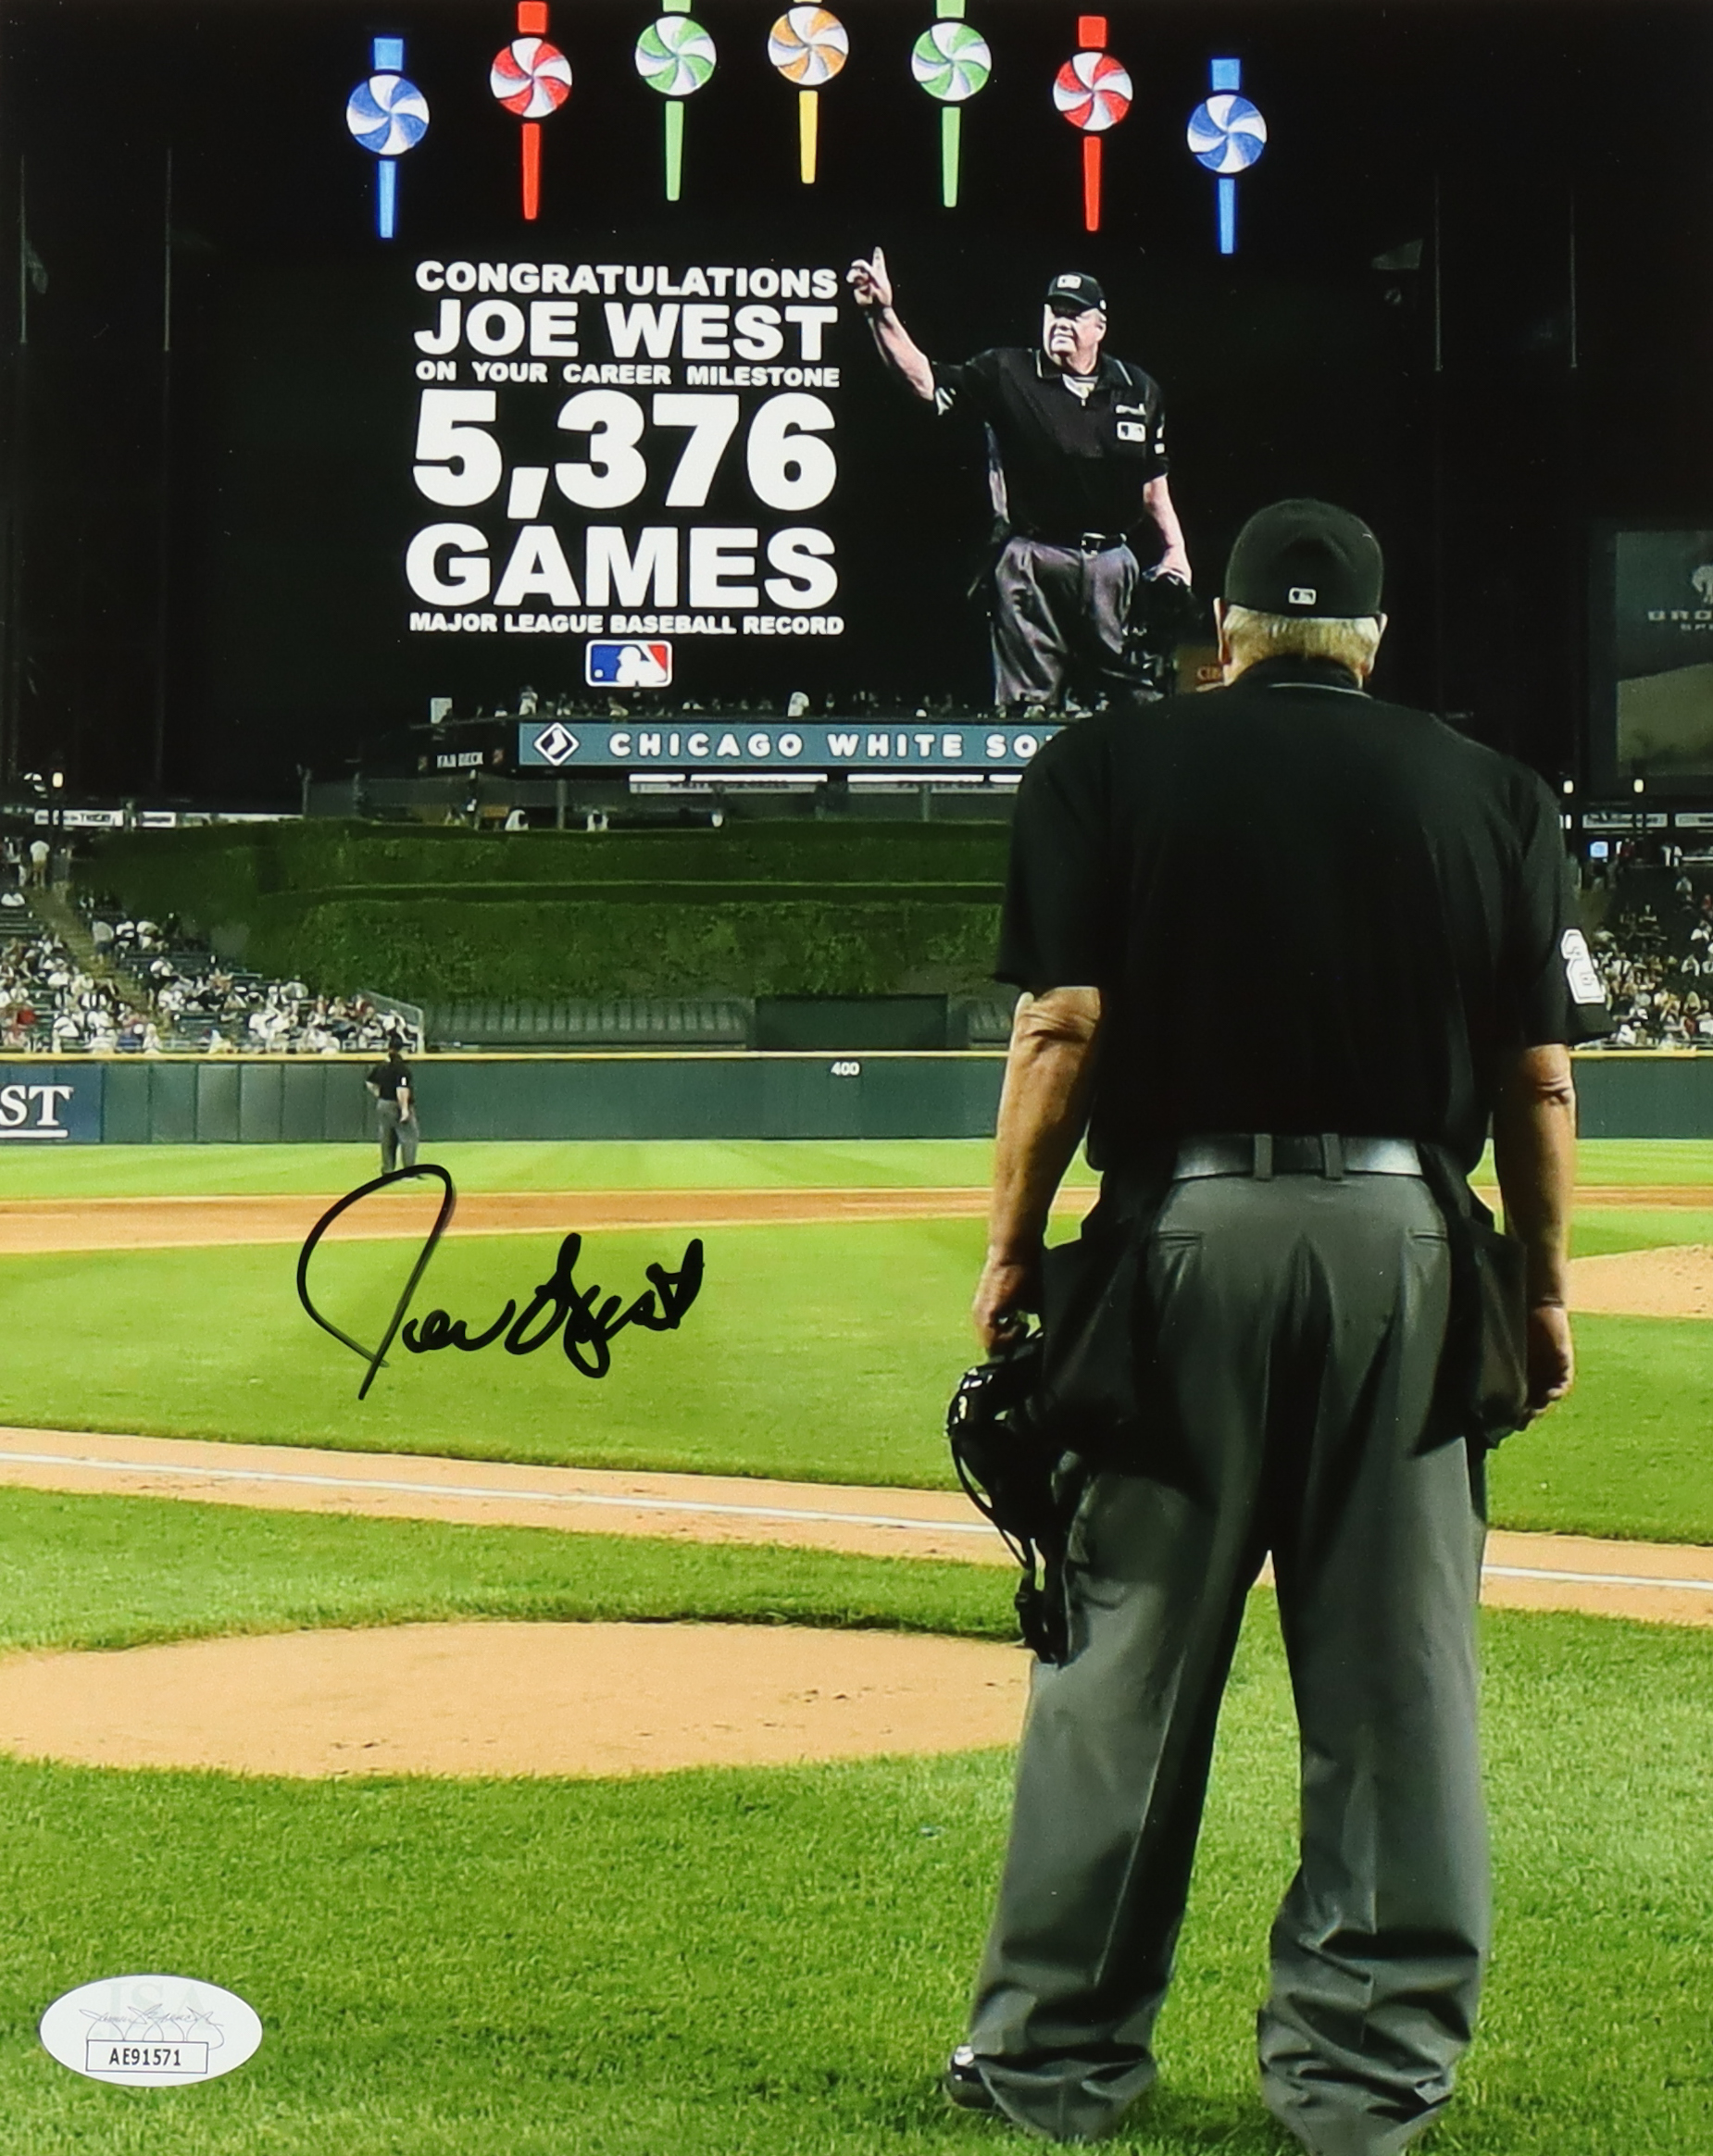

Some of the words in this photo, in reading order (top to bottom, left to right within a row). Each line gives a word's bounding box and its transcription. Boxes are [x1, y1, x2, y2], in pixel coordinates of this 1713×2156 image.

[415, 260, 838, 299] CONGRATULATIONS
[414, 299, 579, 357] JOE
[604, 302, 838, 361] WEST
[416, 360, 456, 381] ON
[471, 361, 548, 383] YOUR
[563, 363, 672, 386] CAREER
[686, 365, 840, 388] MILESTONE
[413, 388, 837, 519] 5,376
[406, 522, 838, 610] GAMES
[409, 612, 498, 633] MAJOR
[504, 613, 604, 634] LEAGUE
[610, 615, 737, 635] BASEBALL
[743, 616, 844, 636] RECORD
[609, 732, 803, 758] CHICAGO
[827, 733, 962, 758] WHITE
[986, 733, 1053, 758] SO
[830, 1061, 860, 1077] 400
[108, 2047, 182, 2067] AE91571
